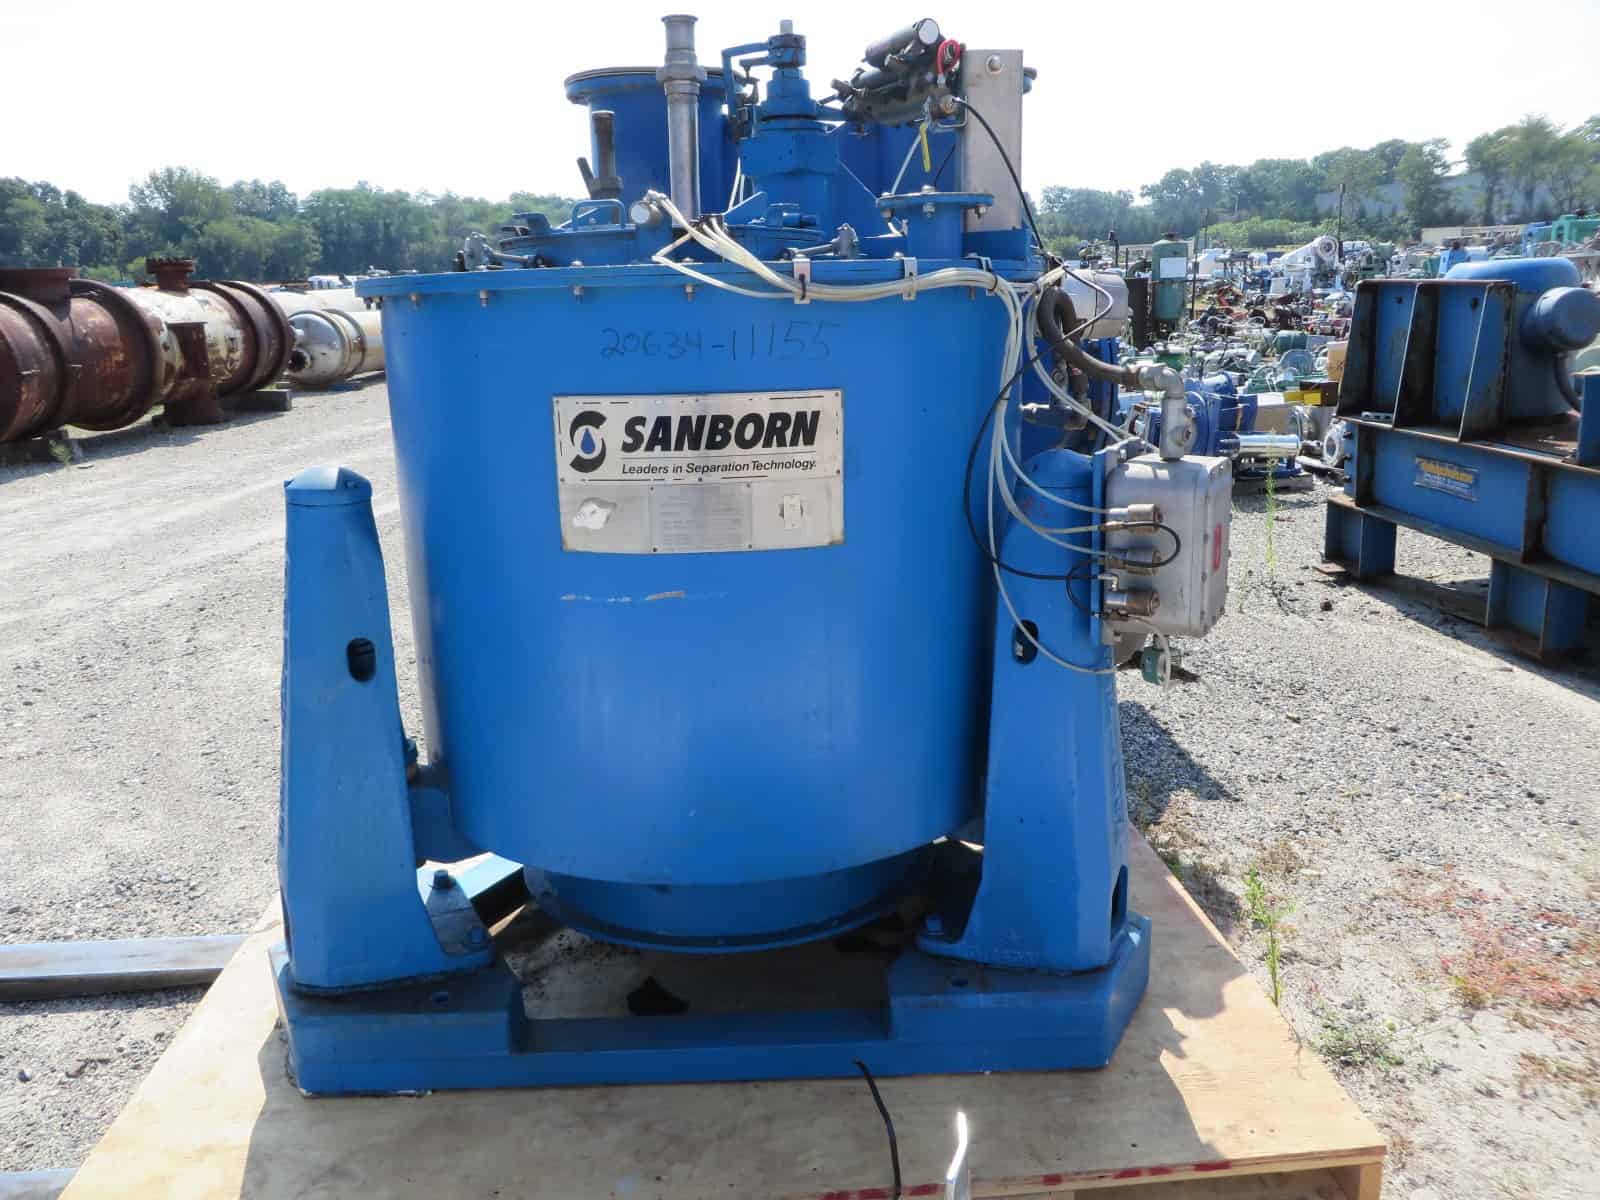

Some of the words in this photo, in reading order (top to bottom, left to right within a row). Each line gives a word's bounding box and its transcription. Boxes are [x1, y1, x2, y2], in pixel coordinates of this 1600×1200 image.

[621, 410, 820, 453] SANBORN
[621, 463, 669, 475] Leaders
[672, 463, 683, 474] in
[685, 461, 750, 476] Separation
